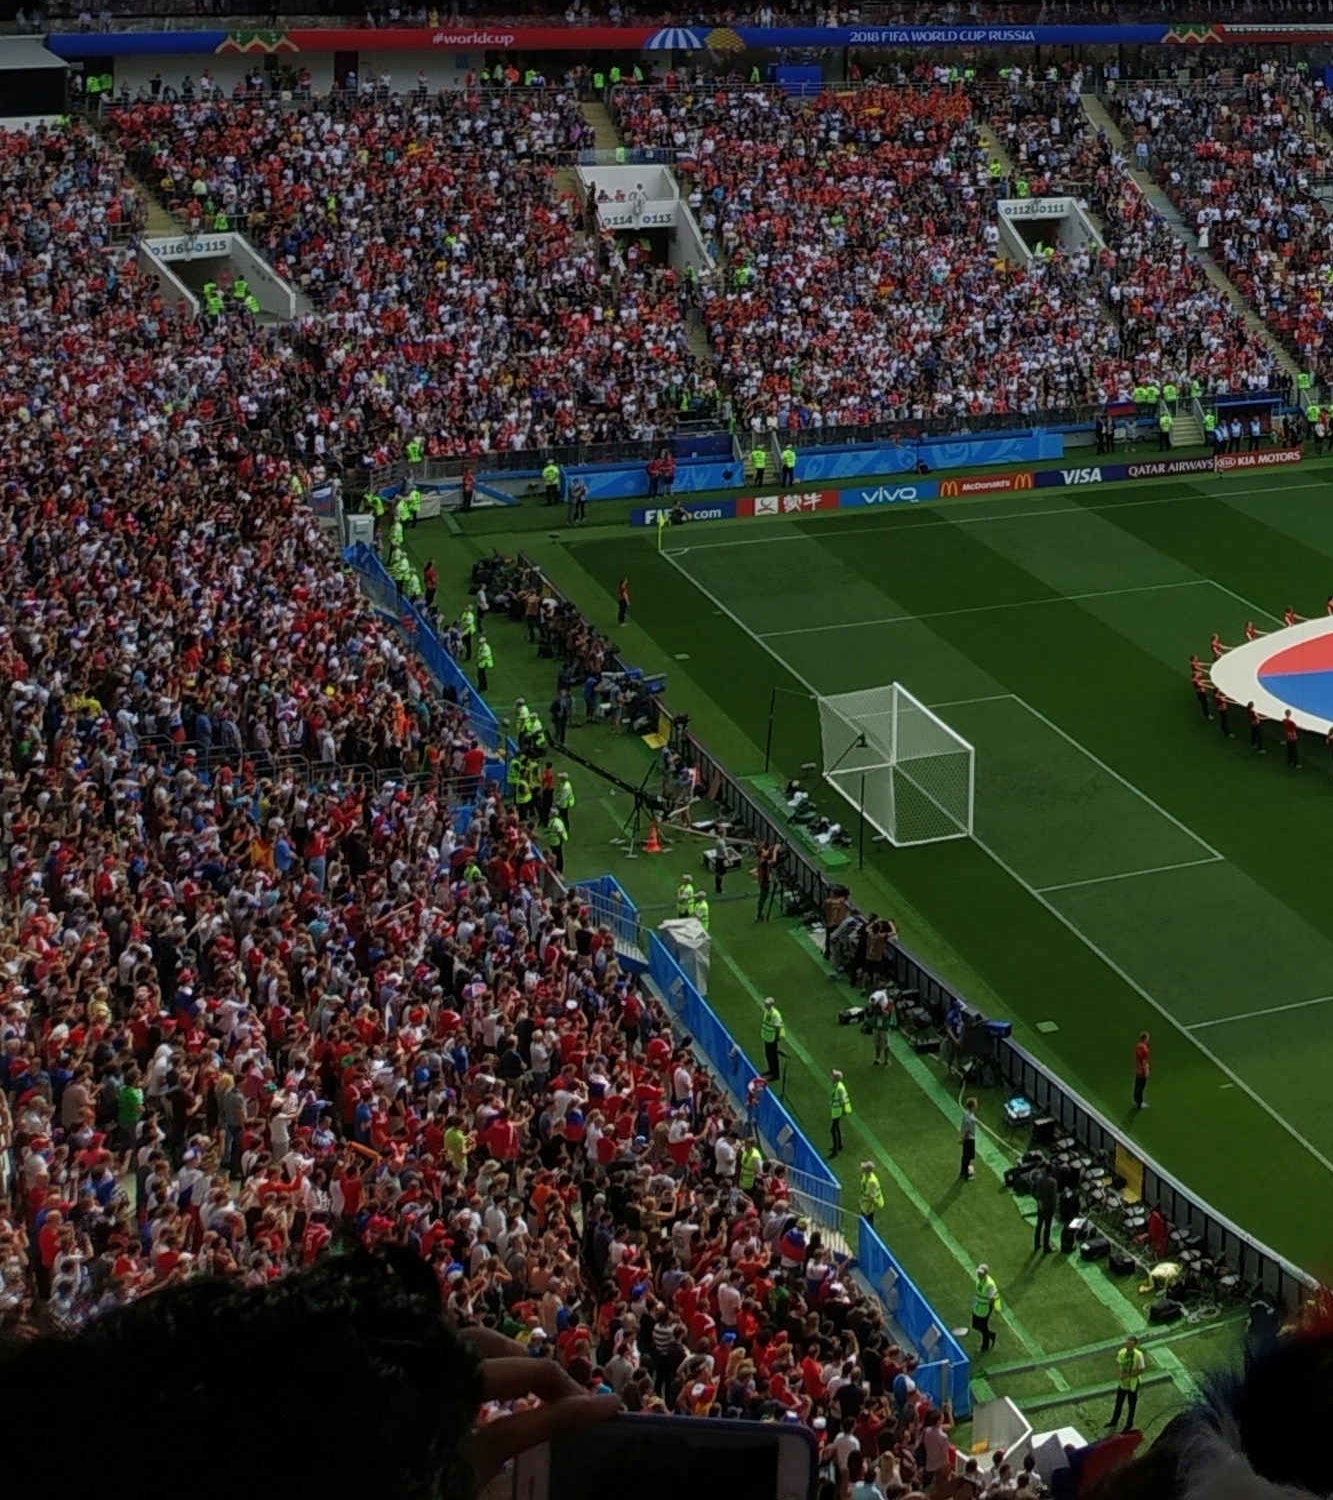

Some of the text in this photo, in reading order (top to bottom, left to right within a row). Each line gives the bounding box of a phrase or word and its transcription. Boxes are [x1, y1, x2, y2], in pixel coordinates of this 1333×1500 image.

[432, 32, 515, 46] #worldcup
[849, 30, 1035, 42] 2018 FIFA WORLD CUP RUSSIA
[1012, 204, 1065, 214] 112 111
[612, 214, 671, 224] 114 113
[160, 241, 227, 255] 116 115
[1238, 455, 1255, 466] KIA
[1258, 450, 1300, 464] MOTORS
[1128, 459, 1214, 477] QATAR AIRWAYS
[1060, 467, 1102, 485] VISA
[962, 479, 1011, 491] McDonald's
[783, 492, 823, 512] 蒙牛
